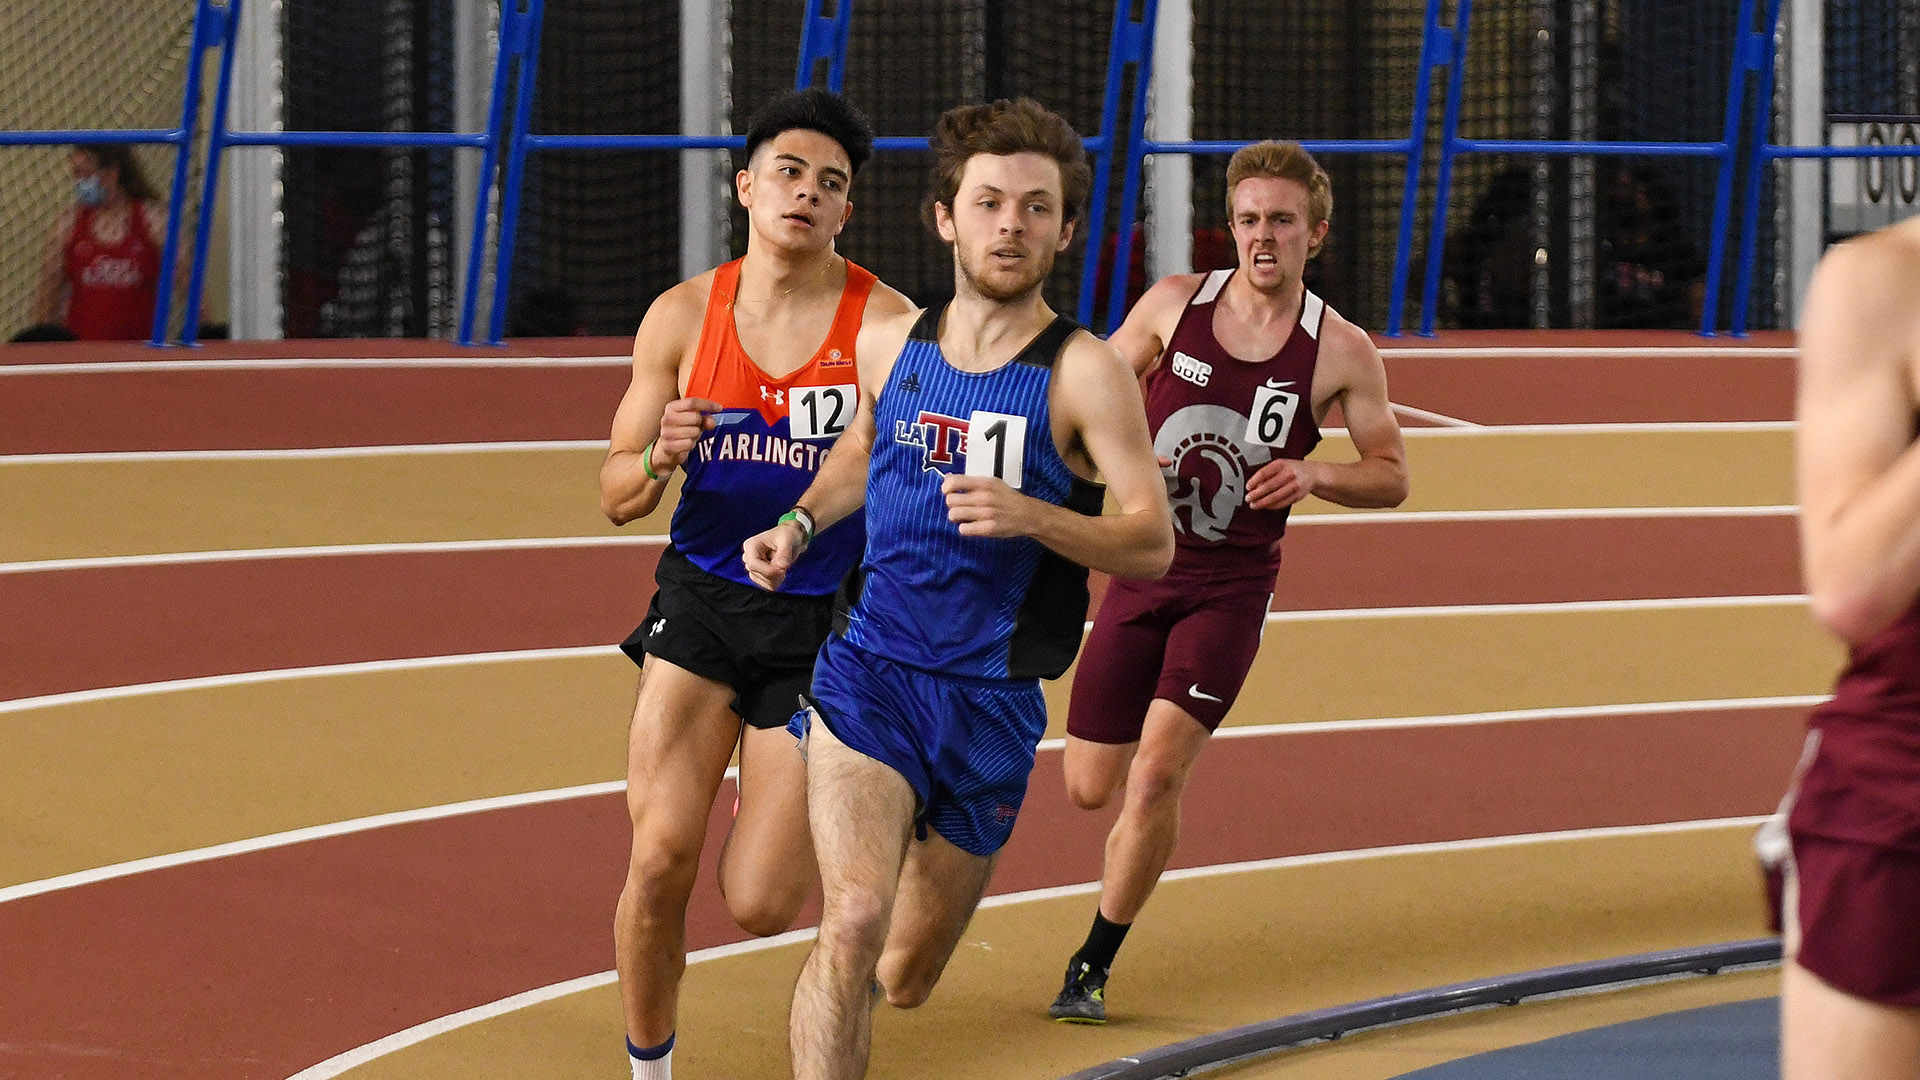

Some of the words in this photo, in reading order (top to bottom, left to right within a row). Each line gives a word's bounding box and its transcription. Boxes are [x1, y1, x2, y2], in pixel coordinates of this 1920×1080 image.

[1172, 351, 1213, 387] SBC
[800, 388, 845, 436] 12
[895, 420, 926, 447] LA
[1257, 395, 1288, 443] 6
[984, 419, 1008, 479] 1
